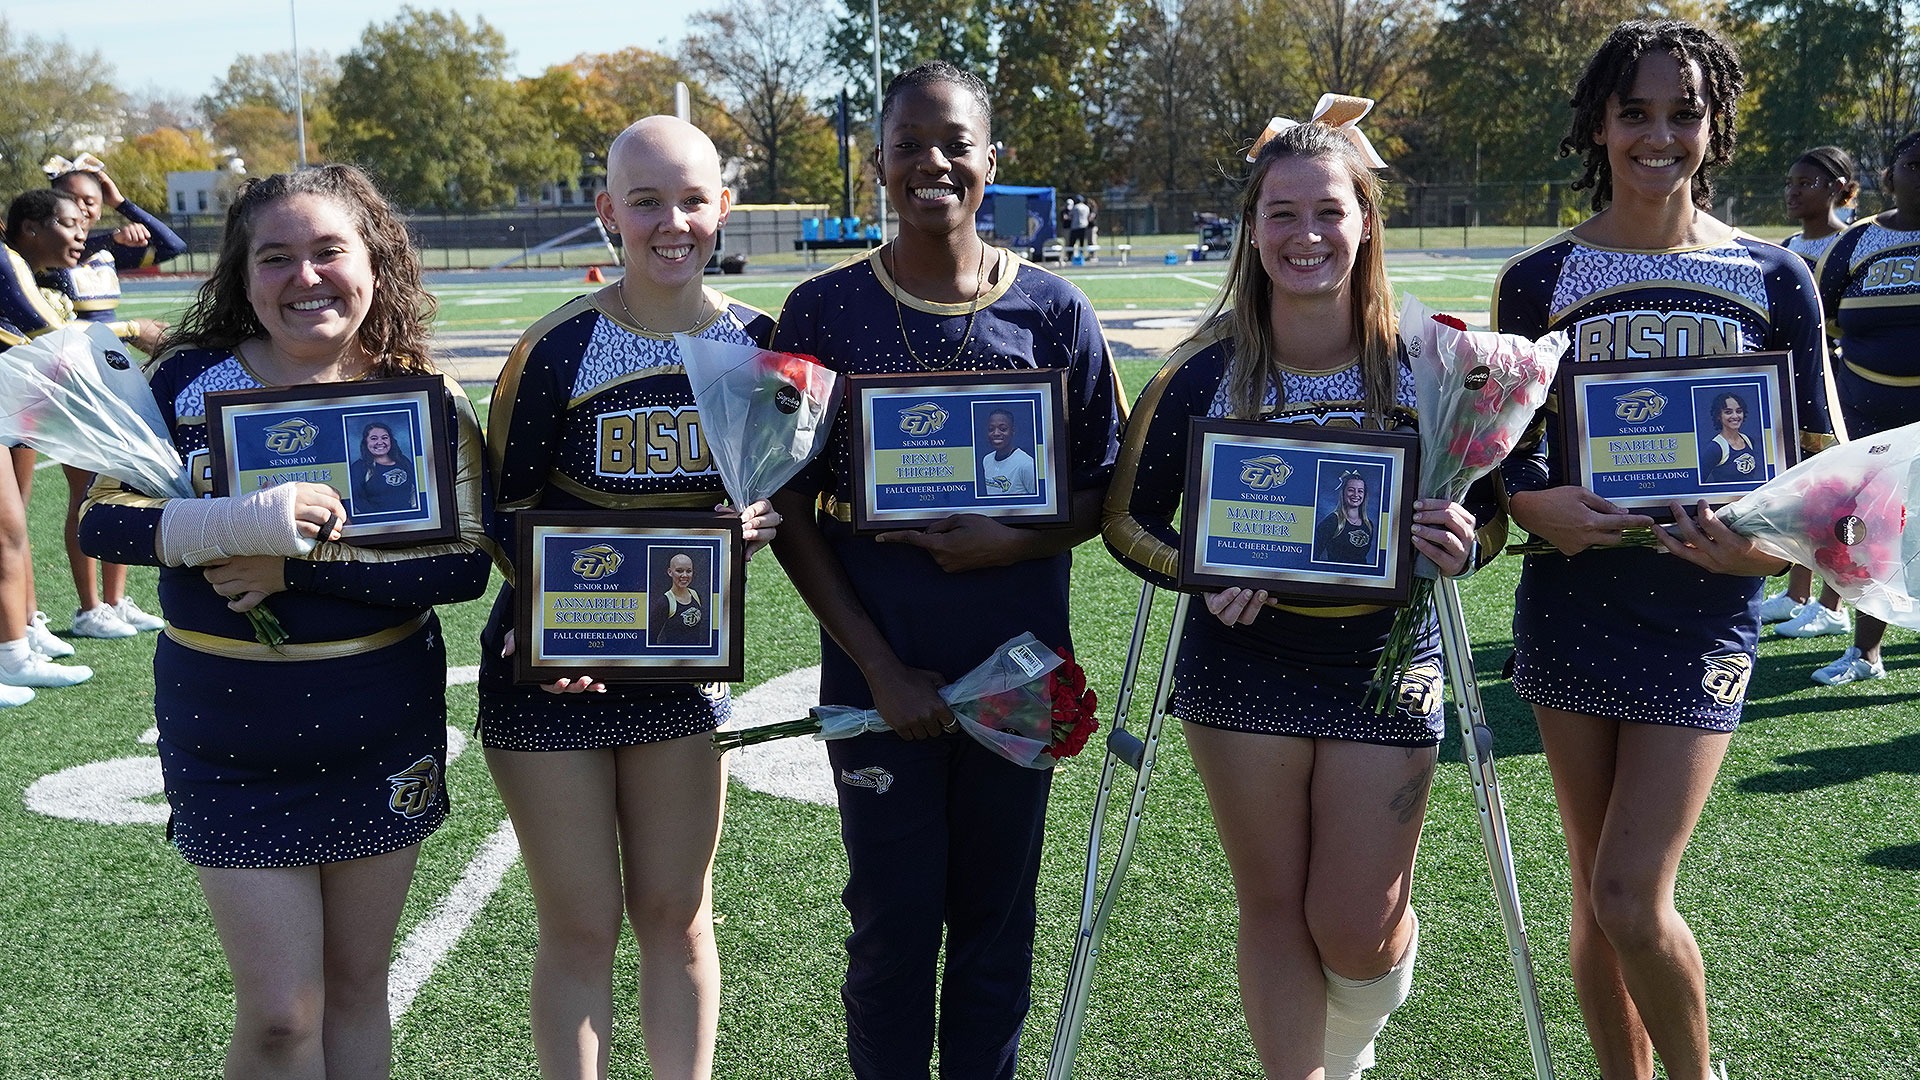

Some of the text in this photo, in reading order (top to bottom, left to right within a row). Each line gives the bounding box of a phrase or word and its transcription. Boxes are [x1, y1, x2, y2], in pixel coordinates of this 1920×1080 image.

[1576, 312, 1743, 361] BISON
[597, 407, 717, 476] BISO
[1608, 438, 1678, 452] ISABELLE
[269, 456, 317, 467] SENIOR DAY
[901, 452, 948, 465] RENAE
[1610, 451, 1677, 465] TAVERAS
[256, 469, 332, 487] DANIELLE
[896, 465, 954, 478] THIGPEN
[1624, 472, 1689, 481] CHEERLEADING
[906, 485, 967, 494] CHEERLEADING
[1240, 492, 1268, 500] SENIOR
[1226, 506, 1298, 523] MARLENA
[1231, 521, 1291, 537] RAUBER
[1217, 540, 1303, 553] FALL CHEERLEADING
[552, 597, 639, 610] ANNABELLE
[554, 611, 636, 624] SCROGGINS
[553, 632, 638, 640] FALL CHEERLEADING
[588, 640, 605, 648] 2023
